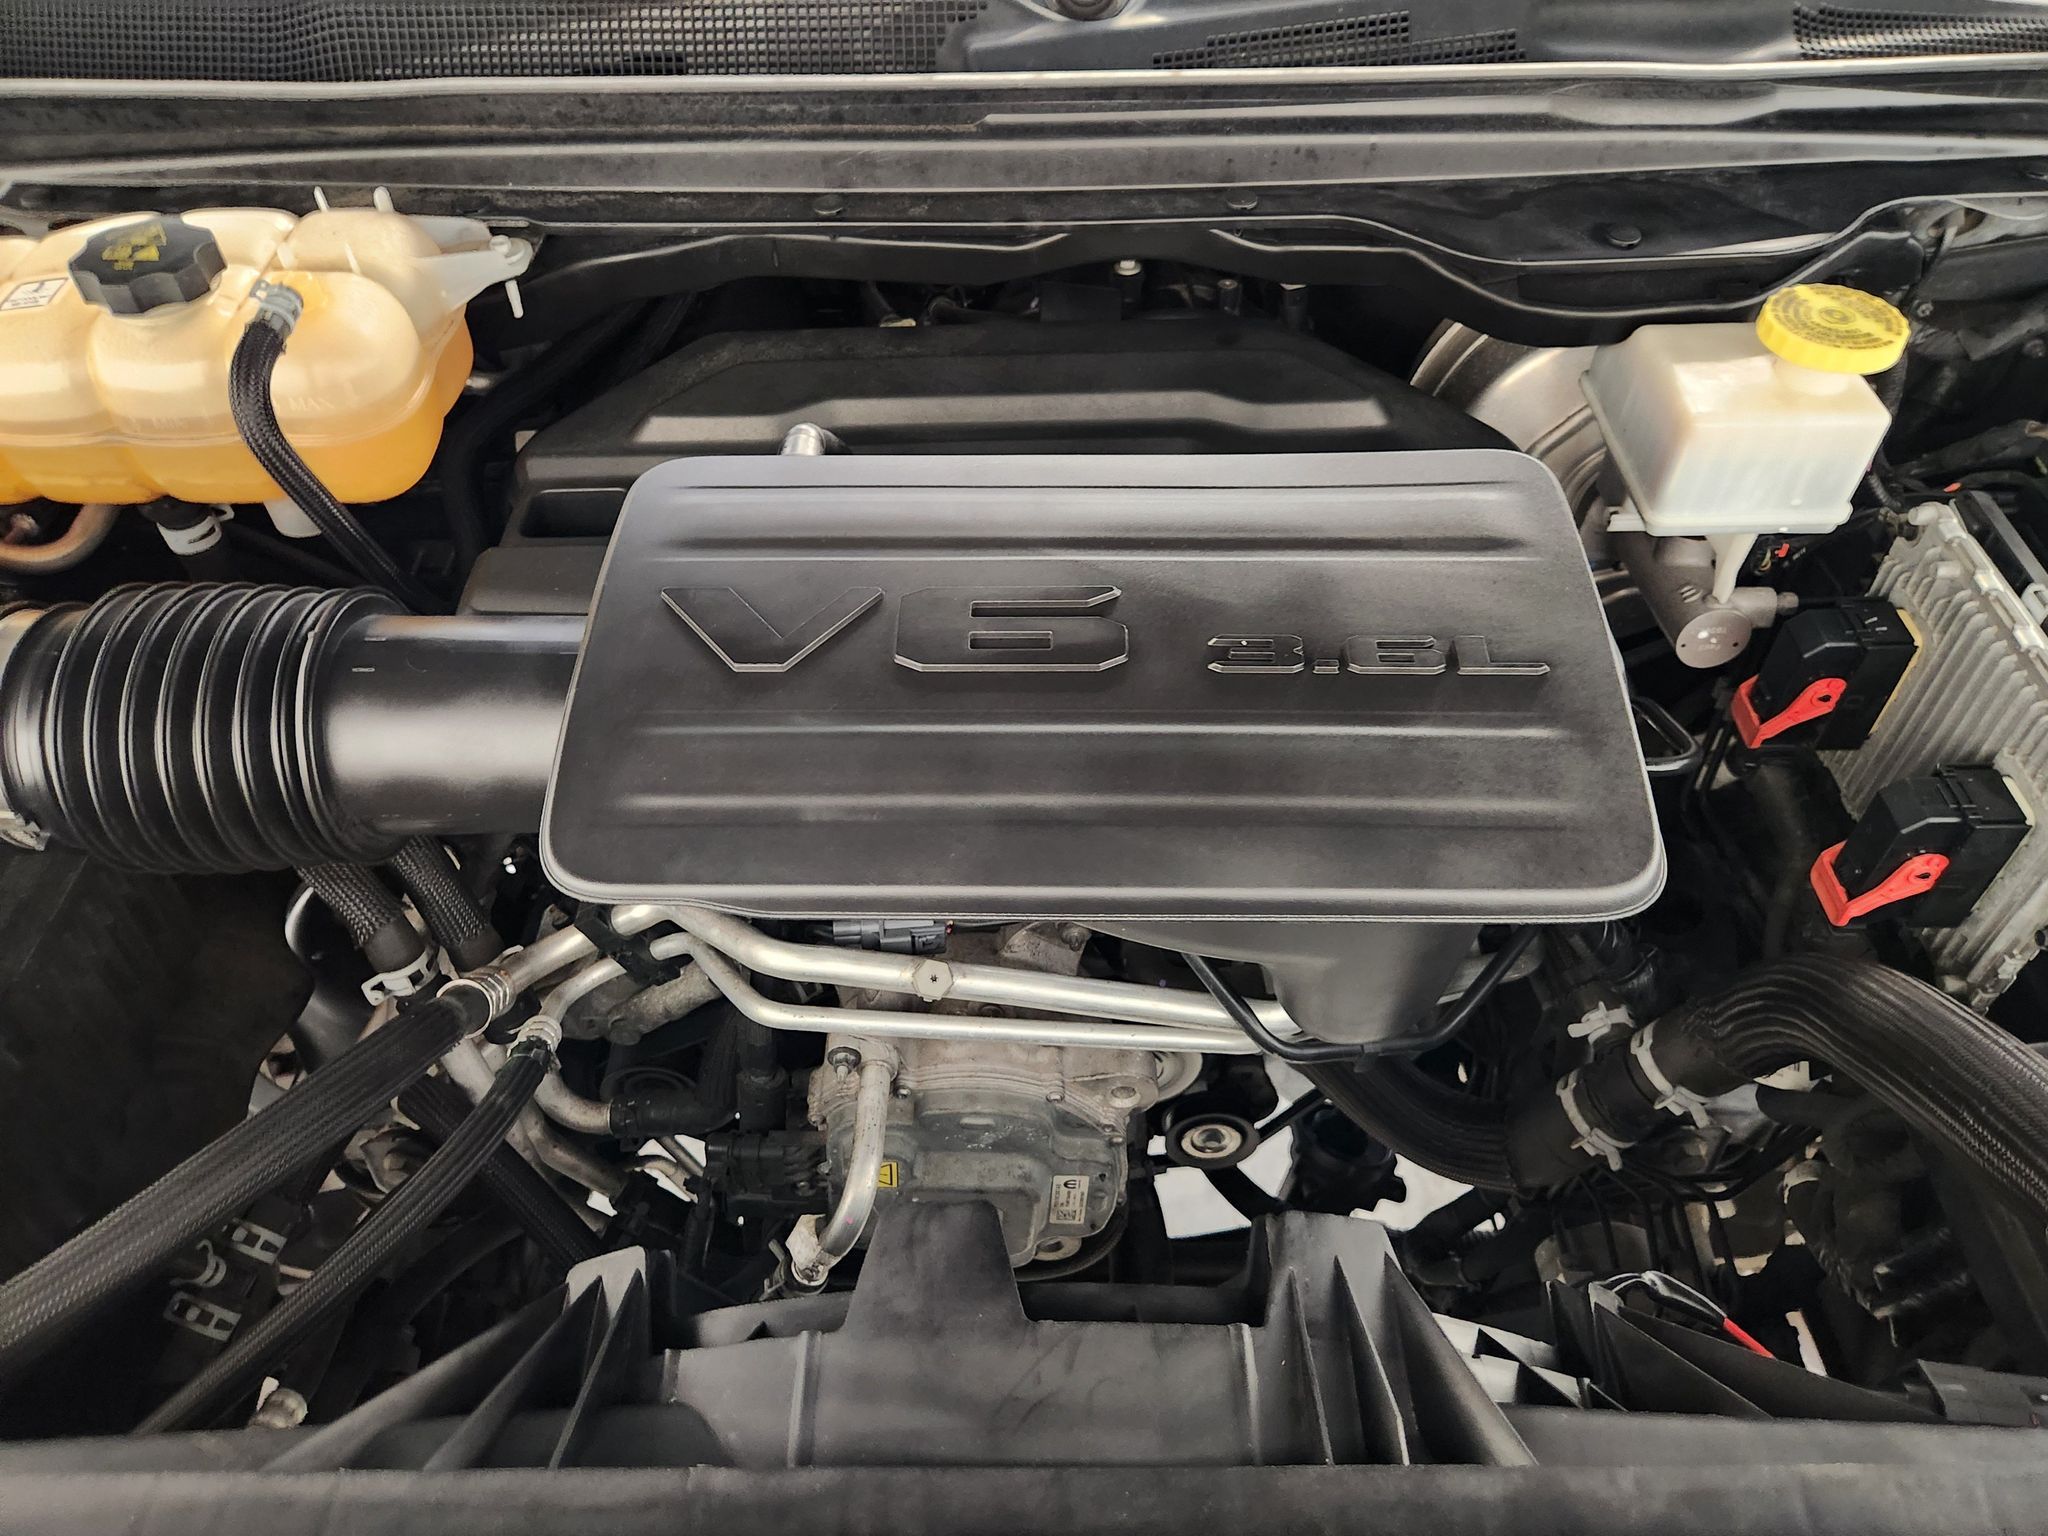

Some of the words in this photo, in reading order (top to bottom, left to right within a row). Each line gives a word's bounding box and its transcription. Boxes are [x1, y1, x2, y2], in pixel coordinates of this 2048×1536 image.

[288, 396, 335, 410] MAX
[661, 585, 1128, 672] V6
[1207, 633, 1550, 675] 3.6L
